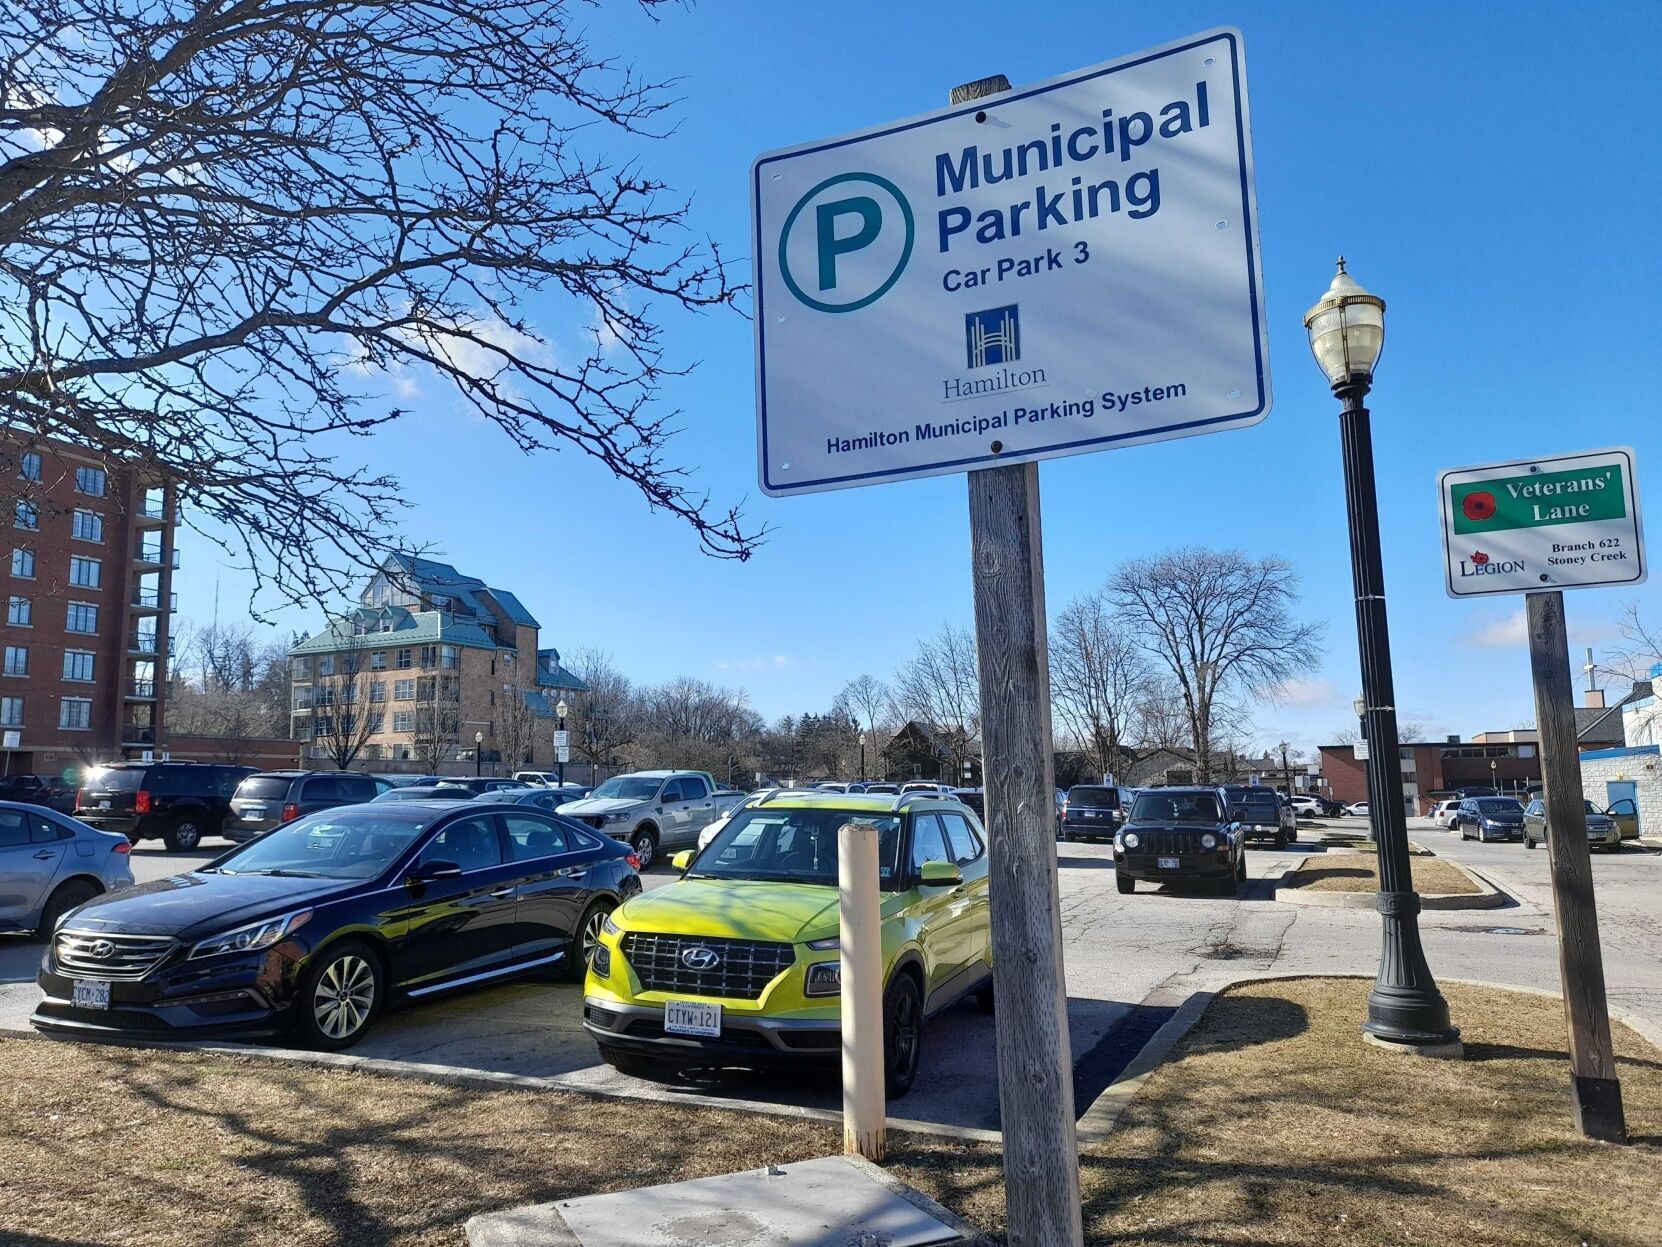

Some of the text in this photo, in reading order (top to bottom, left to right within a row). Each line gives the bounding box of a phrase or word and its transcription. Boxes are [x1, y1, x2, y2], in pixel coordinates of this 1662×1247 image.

[936, 81, 1210, 197] Municipal
[938, 168, 1161, 253] Parking
[816, 196, 882, 291] P
[943, 240, 1090, 292] Car Park 3
[943, 366, 1047, 399] Hamilton
[827, 382, 1187, 454] Hamilton Municipal Parking System
[1505, 472, 1612, 499] Veterans'
[1533, 503, 1590, 522] Lane
[1547, 551, 1627, 566] Stoney Creek
[1552, 538, 1620, 553] Branch 622
[1459, 560, 1525, 577] LEGION
